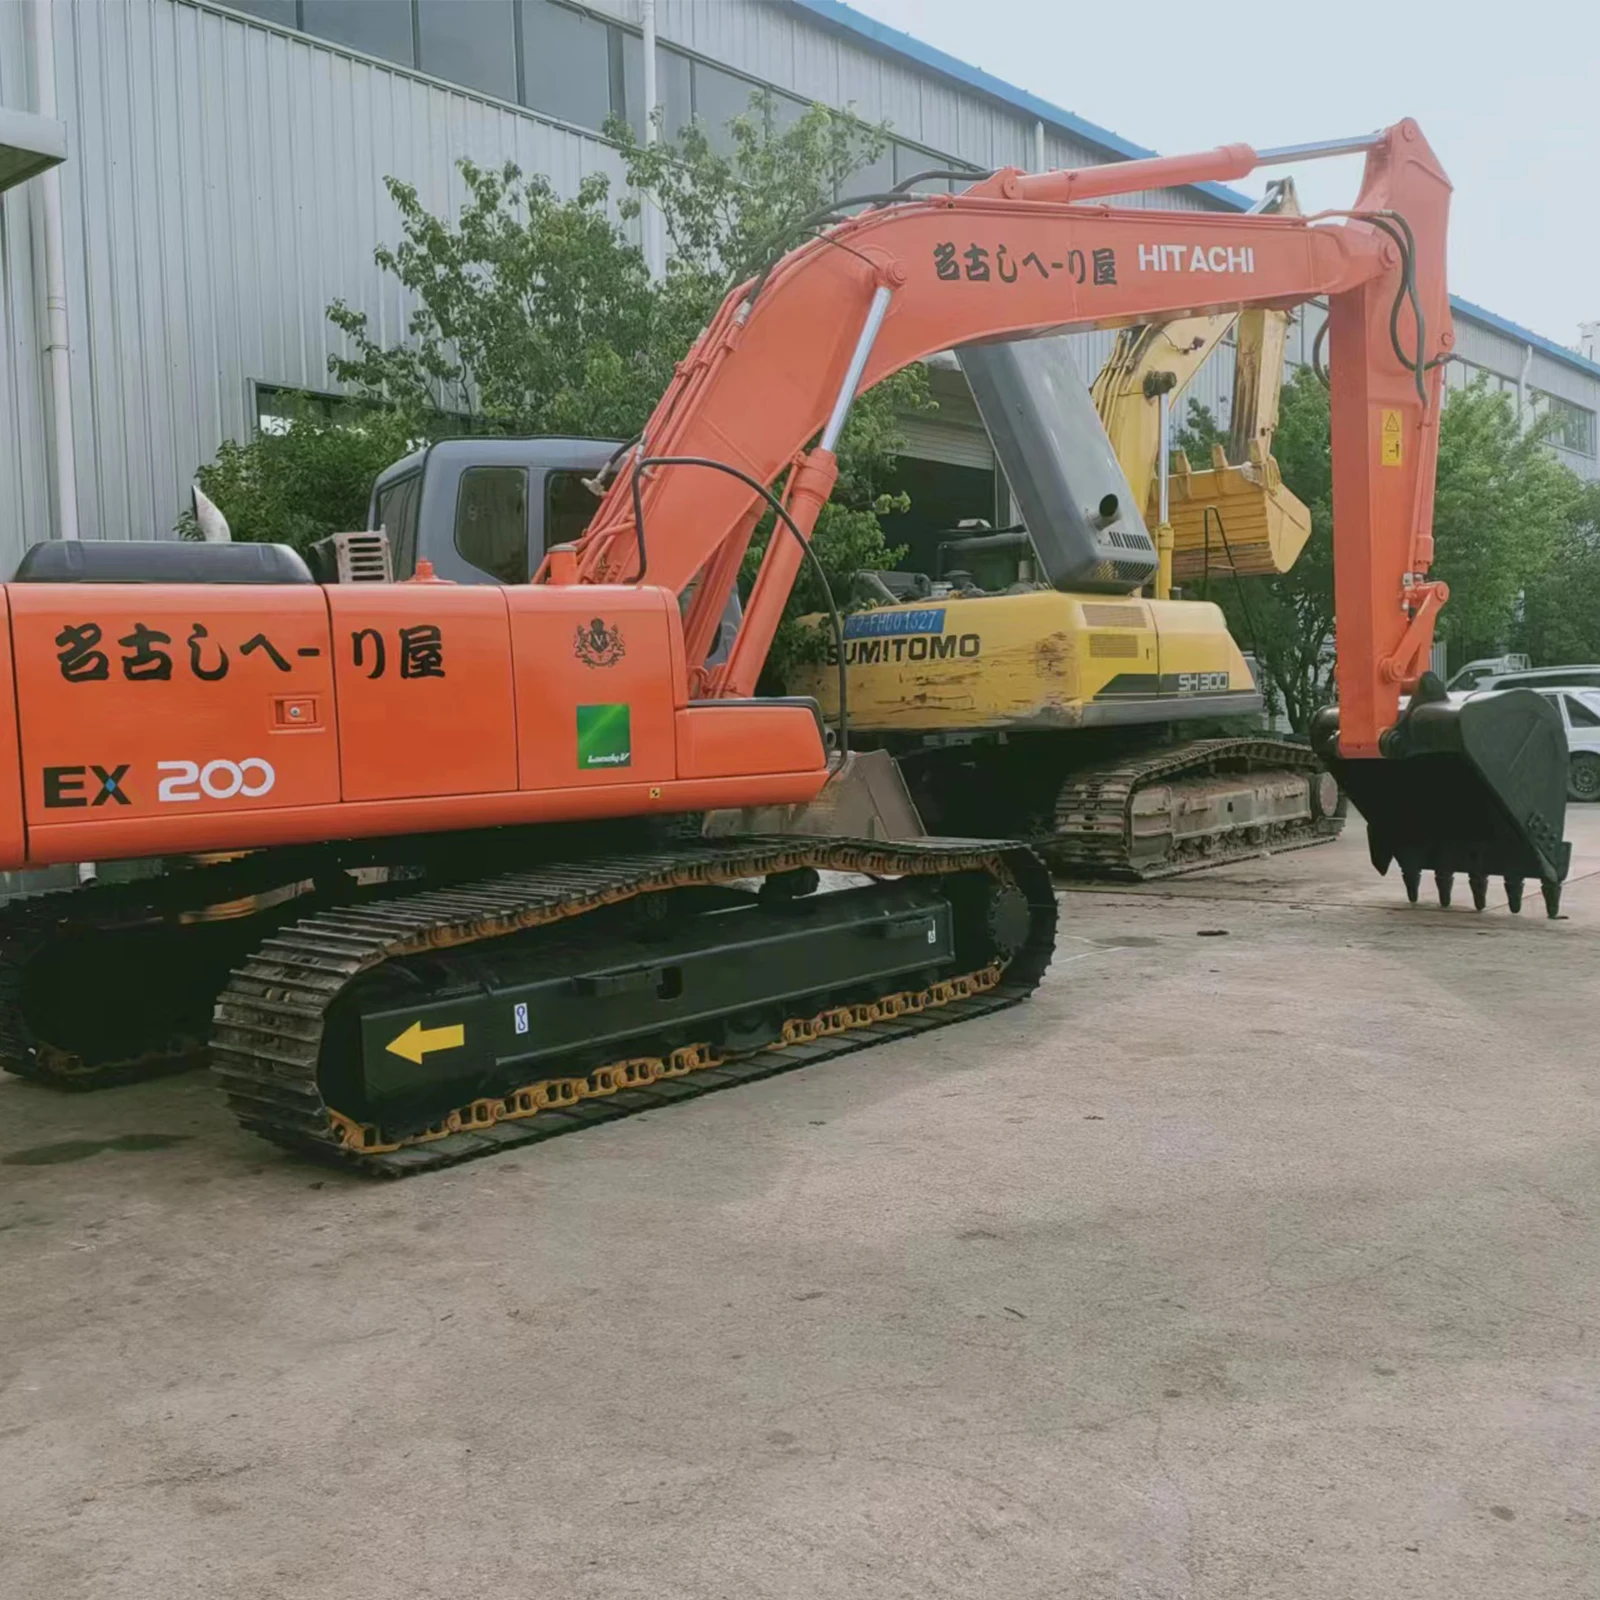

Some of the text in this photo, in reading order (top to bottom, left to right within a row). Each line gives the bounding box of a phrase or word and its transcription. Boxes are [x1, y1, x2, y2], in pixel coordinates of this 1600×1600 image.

[1138, 244, 1254, 273] HITACHI
[827, 634, 980, 666] SUMITOMO
[43, 757, 275, 808] EX 200
